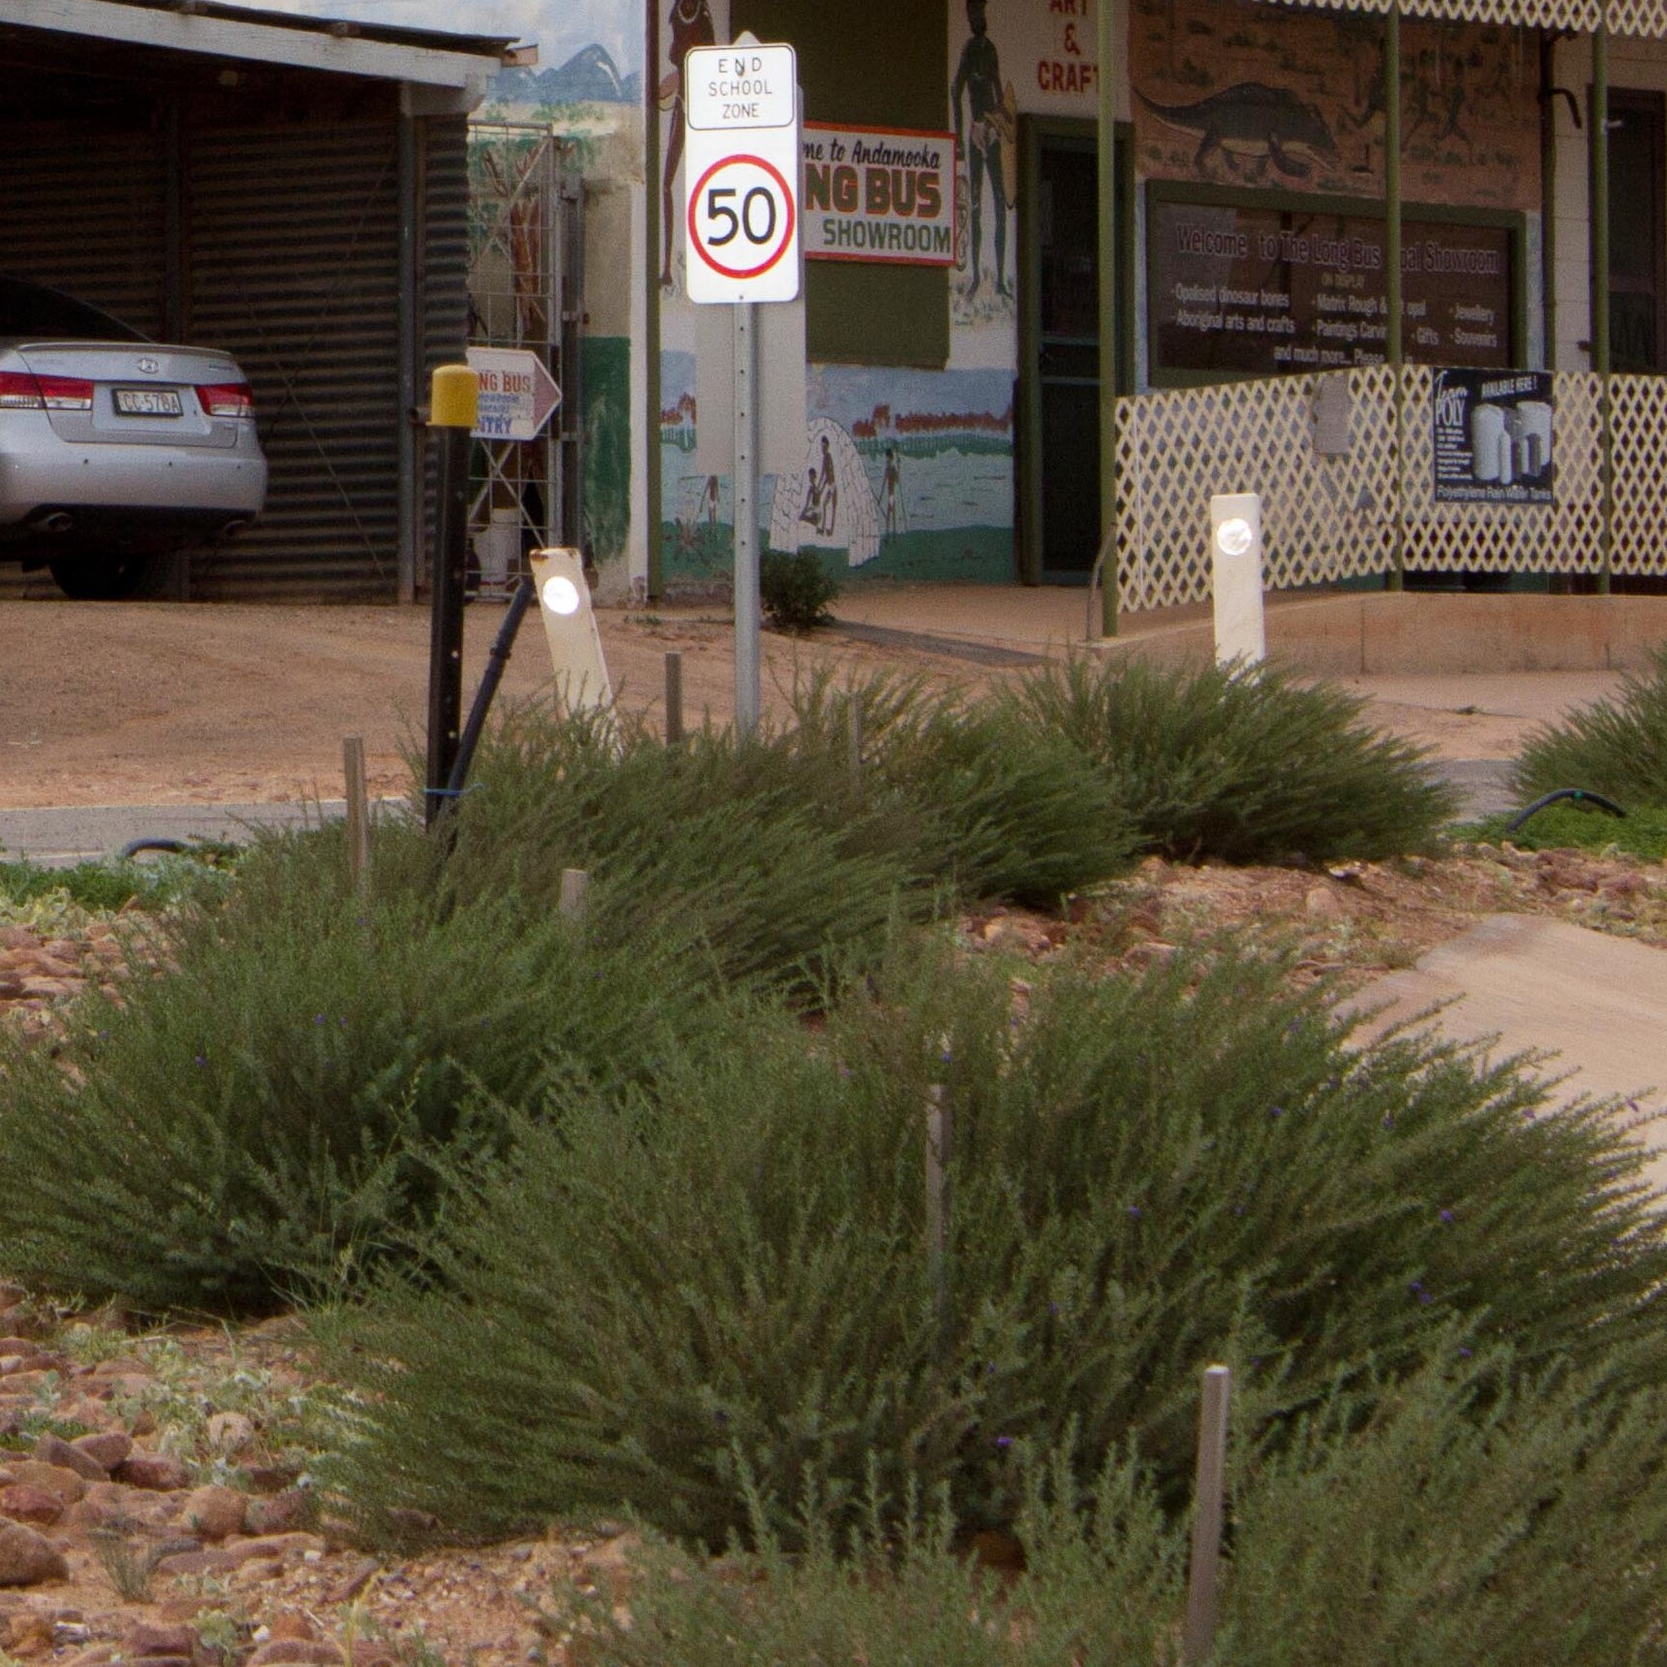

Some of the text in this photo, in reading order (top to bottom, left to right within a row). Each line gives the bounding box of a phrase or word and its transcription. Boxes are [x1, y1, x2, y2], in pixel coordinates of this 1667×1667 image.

[1064, 23, 1081, 55] &
[719, 56, 763, 75] END
[708, 80, 773, 97] SCHOOL
[722, 103, 760, 119] ZONE
[830, 137, 846, 162] to
[852, 139, 940, 168] Andamooka
[805, 163, 943, 219] NG BUS
[707, 186, 777, 247] 50
[823, 218, 951, 254] SHOWROOM
[1176, 222, 1248, 259] Welcome
[1258, 233, 1278, 261] to
[1279, 231, 1309, 264] The
[1312, 234, 1351, 274] Long
[1353, 237, 1382, 270] Bus
[1426, 240, 1500, 274] Showroom
[1218, 286, 1259, 305] dinosaur
[1261, 289, 1289, 307] bones
[1176, 310, 1295, 334] Aboriginal arts and crafts
[1274, 343, 1292, 361] and
[479, 372, 531, 393] NG BUS
[1435, 398, 1465, 425] POLY
